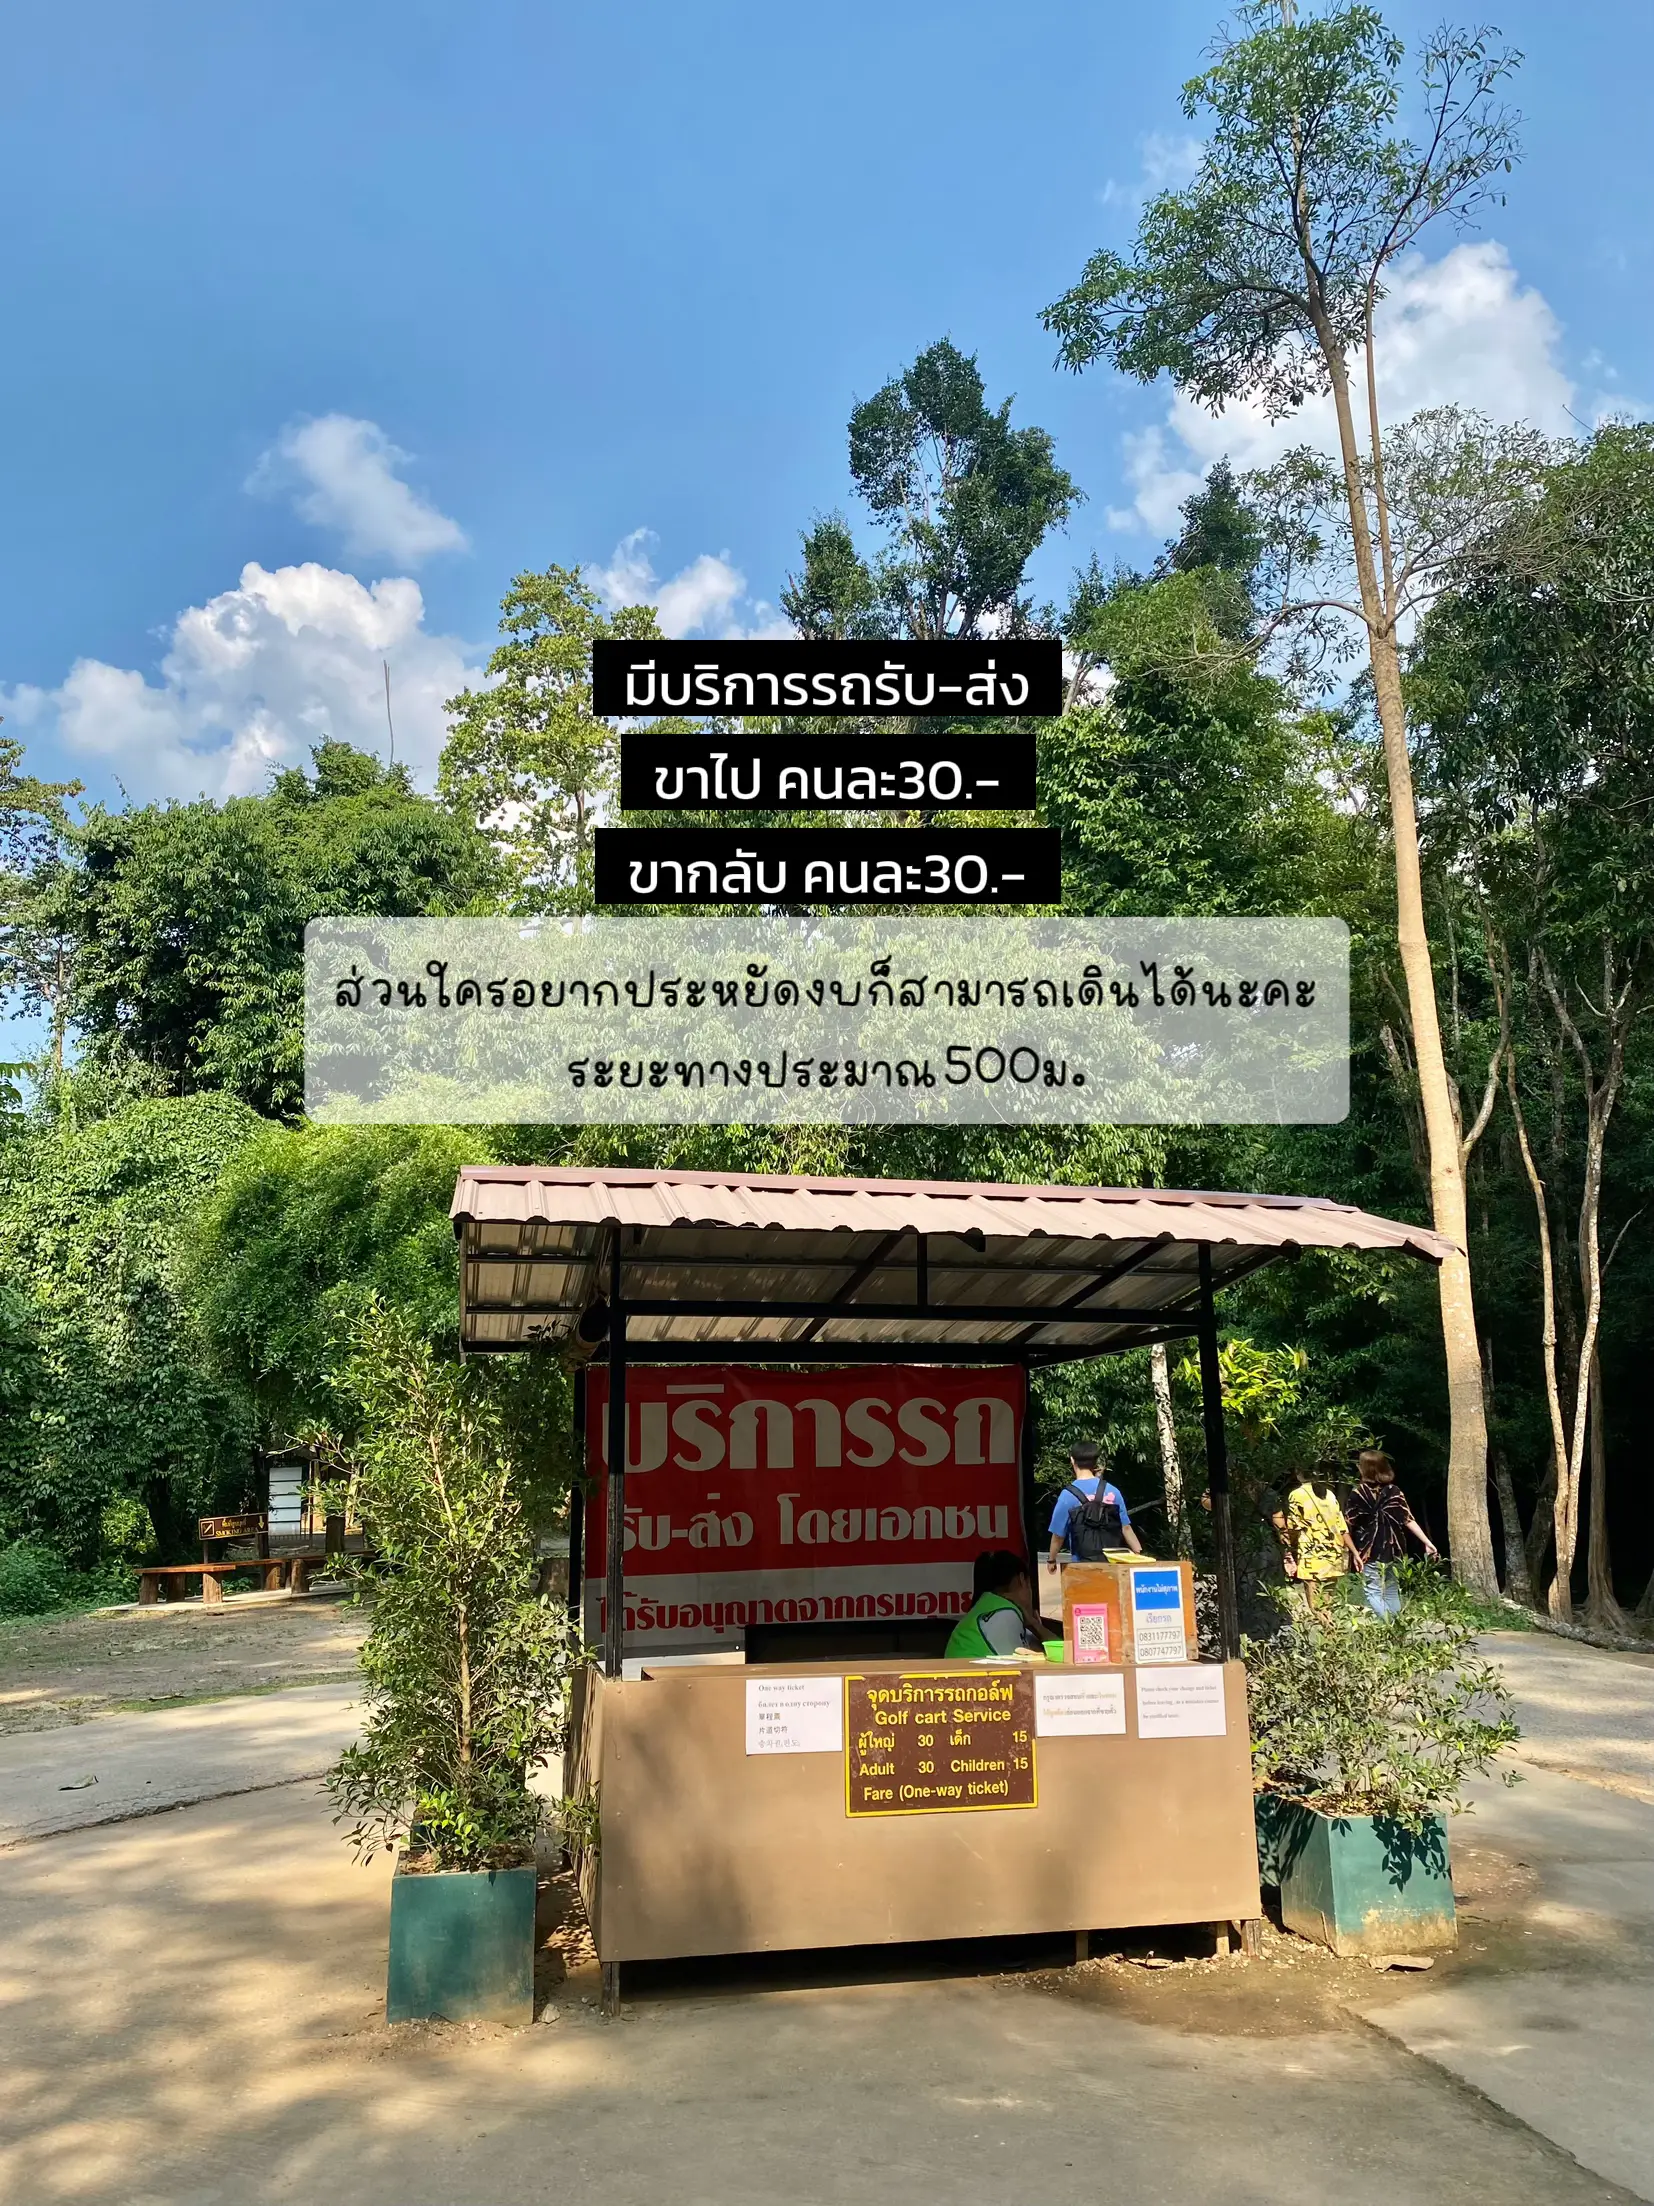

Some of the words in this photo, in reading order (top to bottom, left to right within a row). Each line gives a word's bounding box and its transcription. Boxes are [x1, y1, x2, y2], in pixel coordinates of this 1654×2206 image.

[602, 1384, 1015, 1473] บริการรถ
[623, 1493, 754, 1552] รับ-ส่ง
[777, 1493, 1009, 1545] โดยเอกชน
[1146, 1612, 1172, 1624] เรียกรถ
[1139, 1630, 1181, 1642] 0831177797
[1140, 1645, 1182, 1657] 0807747797
[758, 1684, 771, 1692] One
[773, 1685, 785, 1693] way
[787, 1683, 805, 1692] ticket
[867, 1680, 1013, 1711] จุดบริการรถกอล์ฟ
[875, 1710, 909, 1725] Golf
[915, 1711, 947, 1725] cart
[952, 1708, 1011, 1723] Service
[858, 1730, 895, 1757] ผู้ใหญ่
[917, 1734, 934, 1747] 30
[949, 1728, 972, 1746] เด็ก
[1012, 1730, 1028, 1743] 15
[859, 1763, 895, 1777] Adult
[918, 1760, 934, 1774] 30
[950, 1758, 1005, 1773] Children
[1013, 1757, 1029, 1770] 15
[864, 1787, 894, 1801] Fare
[899, 1784, 963, 1802] (One-way
[967, 1780, 1009, 1797] ticket)
